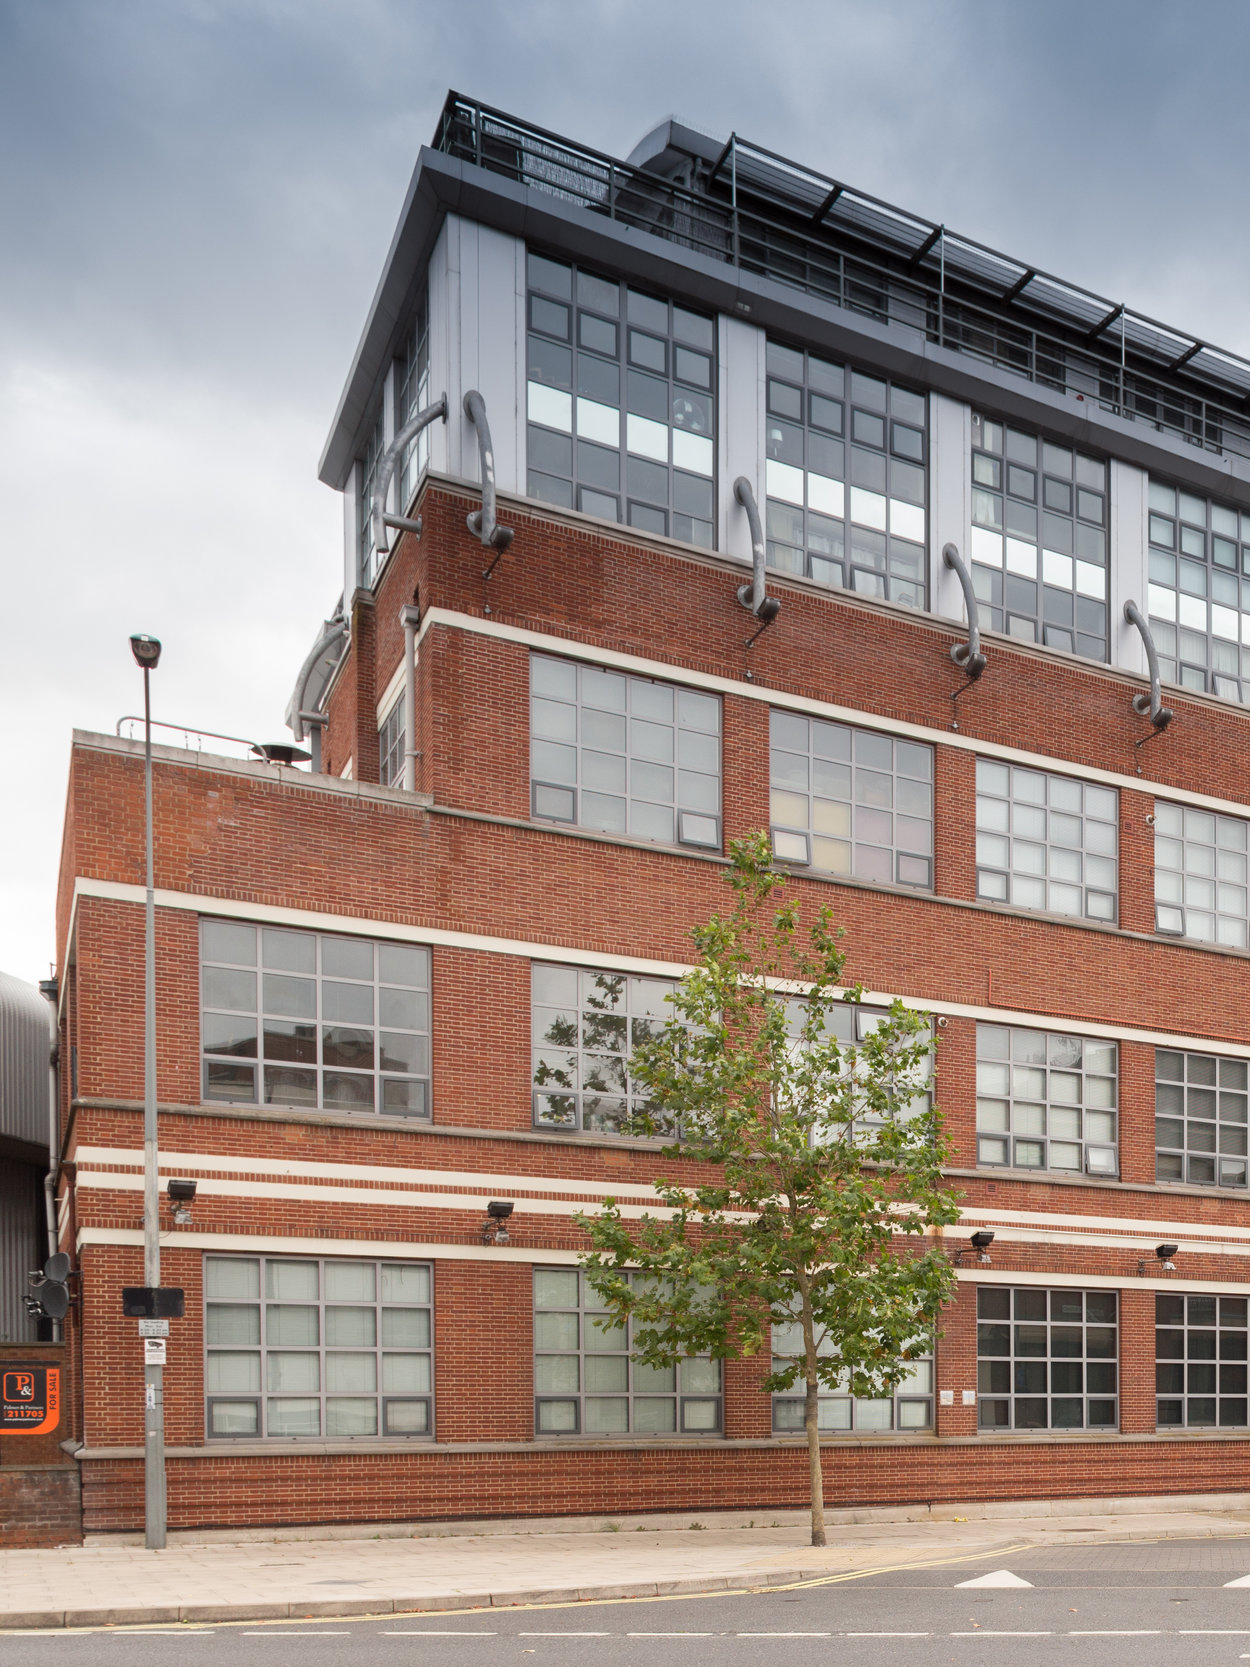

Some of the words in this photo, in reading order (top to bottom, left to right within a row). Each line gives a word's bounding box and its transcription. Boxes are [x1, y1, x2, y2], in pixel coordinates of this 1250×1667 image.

[49, 1373, 57, 1391] SALE
[49, 1394, 57, 1410] FOR
[7, 1410, 44, 1418] 211705
